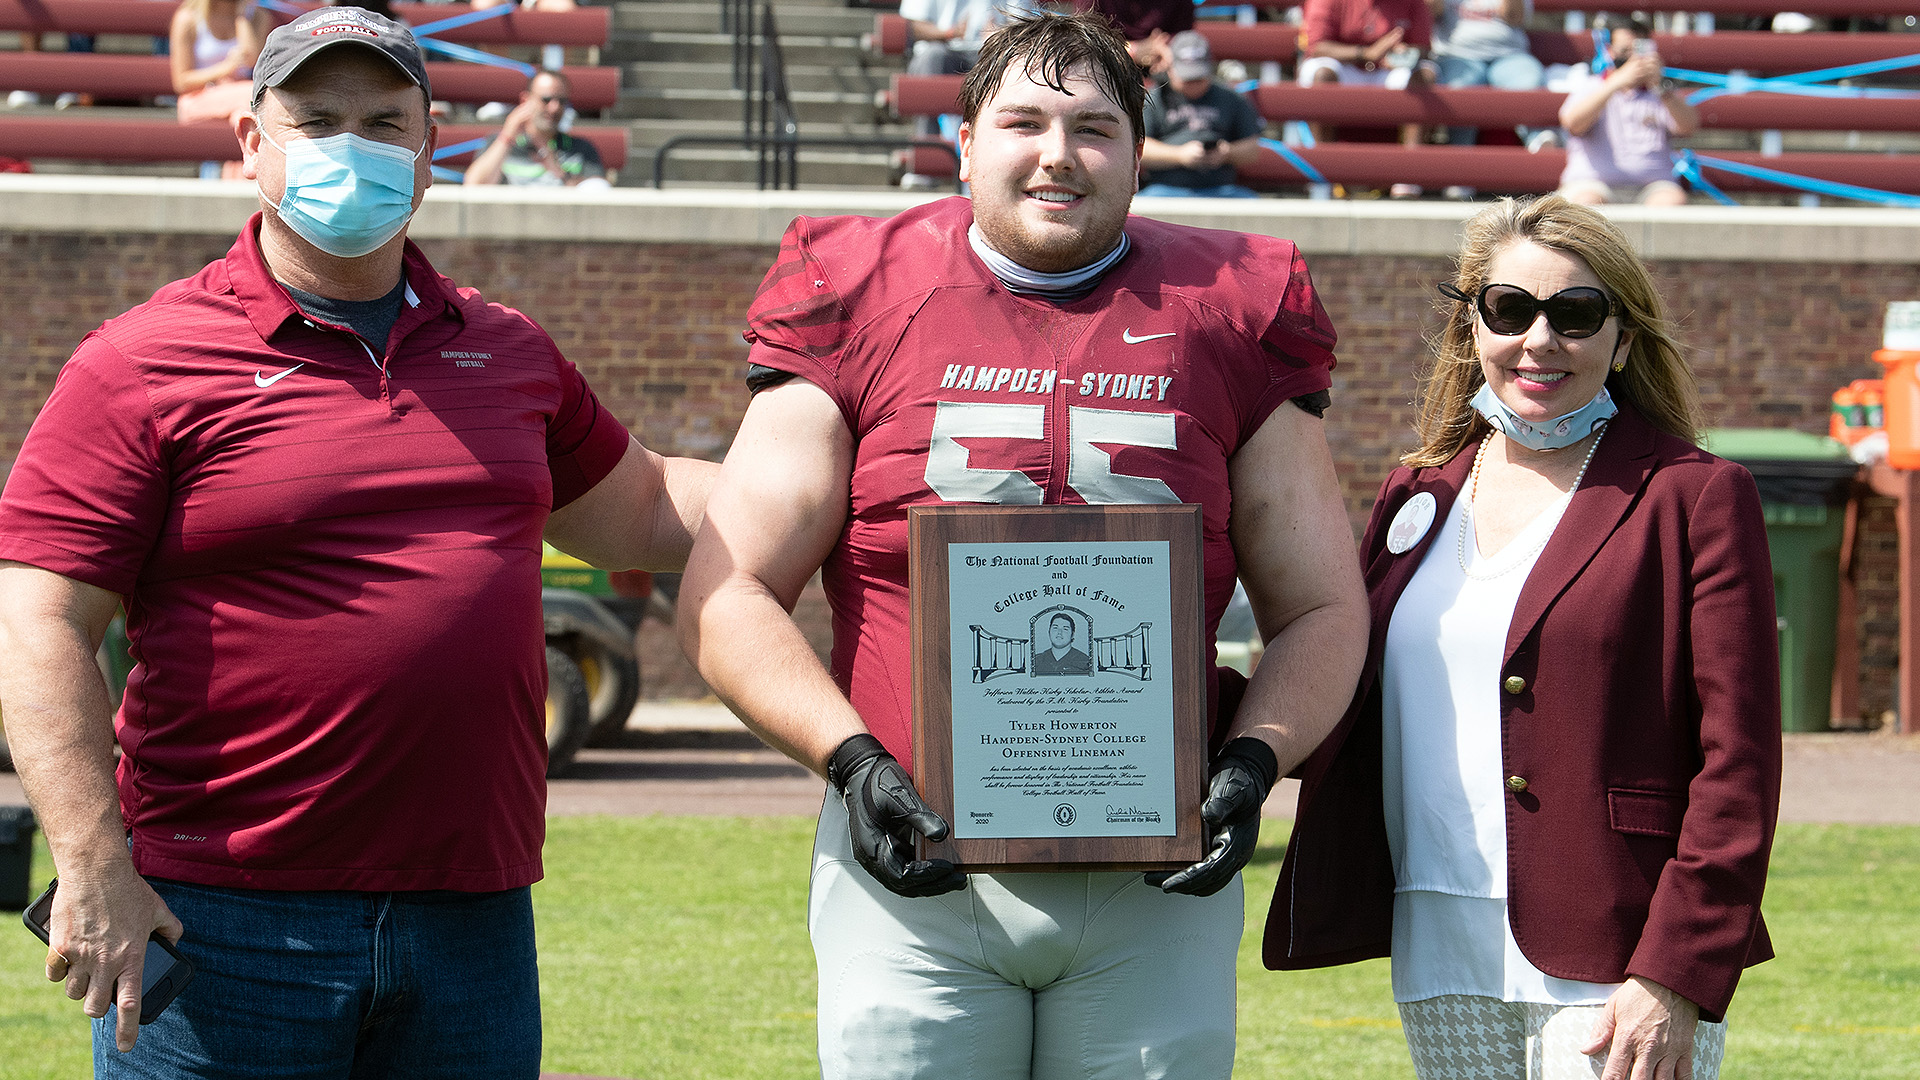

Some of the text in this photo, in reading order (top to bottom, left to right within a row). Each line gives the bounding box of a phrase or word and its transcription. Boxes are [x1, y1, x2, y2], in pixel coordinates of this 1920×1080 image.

[316, 25, 376, 36] FOOTBALL
[455, 360, 486, 368] FOOTBALL
[924, 400, 1183, 505] 55
[965, 554, 1154, 568] The National Football Foundation
[1051, 571, 1068, 580] and
[993, 584, 1125, 613] College Hall of Fame
[173, 833, 207, 842] DRI-FIT
